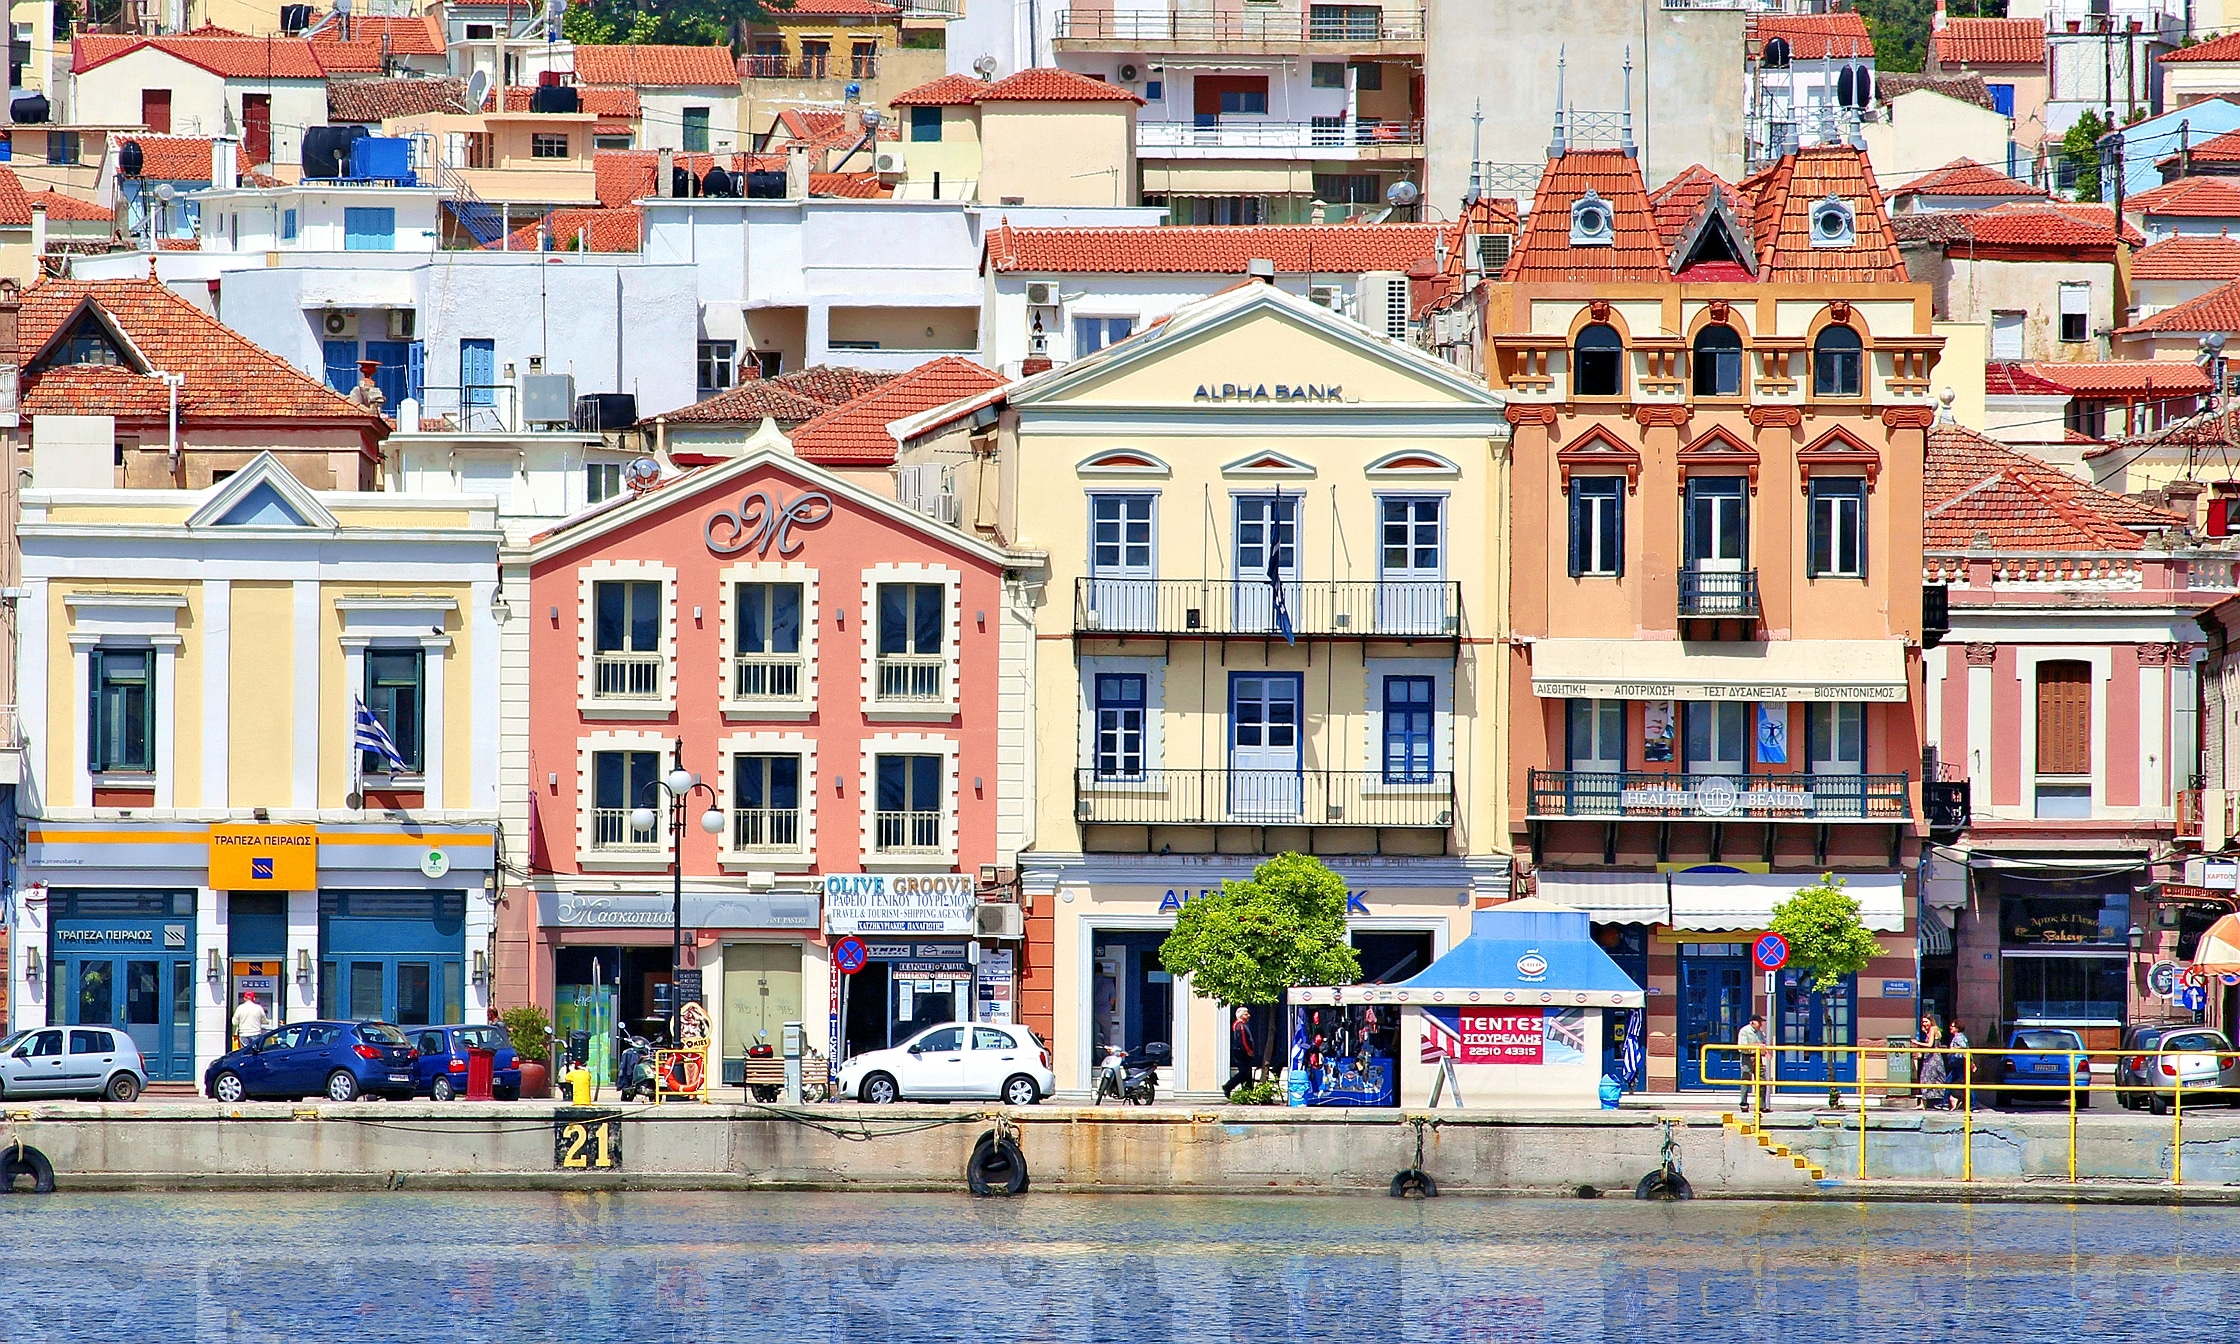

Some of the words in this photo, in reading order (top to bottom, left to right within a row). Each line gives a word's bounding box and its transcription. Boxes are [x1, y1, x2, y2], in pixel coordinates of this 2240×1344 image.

[1193, 383, 1269, 402] ALPHA
[1275, 383, 1344, 402] BANK
[1536, 684, 1587, 695] ΑΙΣΘΗΤΙΚΗ
[1614, 685, 1675, 696] ΑΠΟΤΡΙΧΩΣΗ
[1703, 686, 1726, 697] ΤΕΣΤ
[1728, 687, 1788, 698] ΔΥΣΑΝΕΞΙΑΣ
[1814, 687, 1895, 698] ΒΙΟΣΥΝΤΟΝΙΣΜΟΣ
[1626, 793, 1689, 806] HEALTH
[1749, 795, 1807, 807] BEAUTY
[214, 835, 262, 846] ΤΡΑΠΕΖΑ
[264, 835, 311, 846] ΠΕΙΡΑΙΩΣ
[827, 876, 885, 895] OLIVE
[892, 876, 972, 896] GROOVE
[828, 894, 867, 907] ΓΡΑΦΕΙΟ
[871, 894, 911, 907] ΓΕΝΙΚΟΥ
[917, 894, 970, 908] ΤΟΥΡΙΣΜΟΥ
[832, 908, 859, 919] TRAVEL
[868, 909, 900, 919] TOURISM
[903, 909, 936, 919] SHIPPING
[938, 909, 967, 919] AGENCY
[57, 930, 104, 940] ΤΡΑΠΕΖΑ
[105, 930, 153, 940] ΠΕΙΡΑΙΩΣ
[2041, 929, 2086, 944] Bakery
[867, 946, 909, 954] LYMPIC
[1460, 1016, 1543, 1031] ΤΕΝΤΕΣ
[1463, 1033, 1542, 1044] ΣΓΟΥΡΕΛΛΗΣ
[830, 1019, 838, 1077] TICKETS
[1469, 1047, 1501, 1056] 22510
[1504, 1047, 1537, 1056] 43315
[562, 1122, 612, 1168] 21
